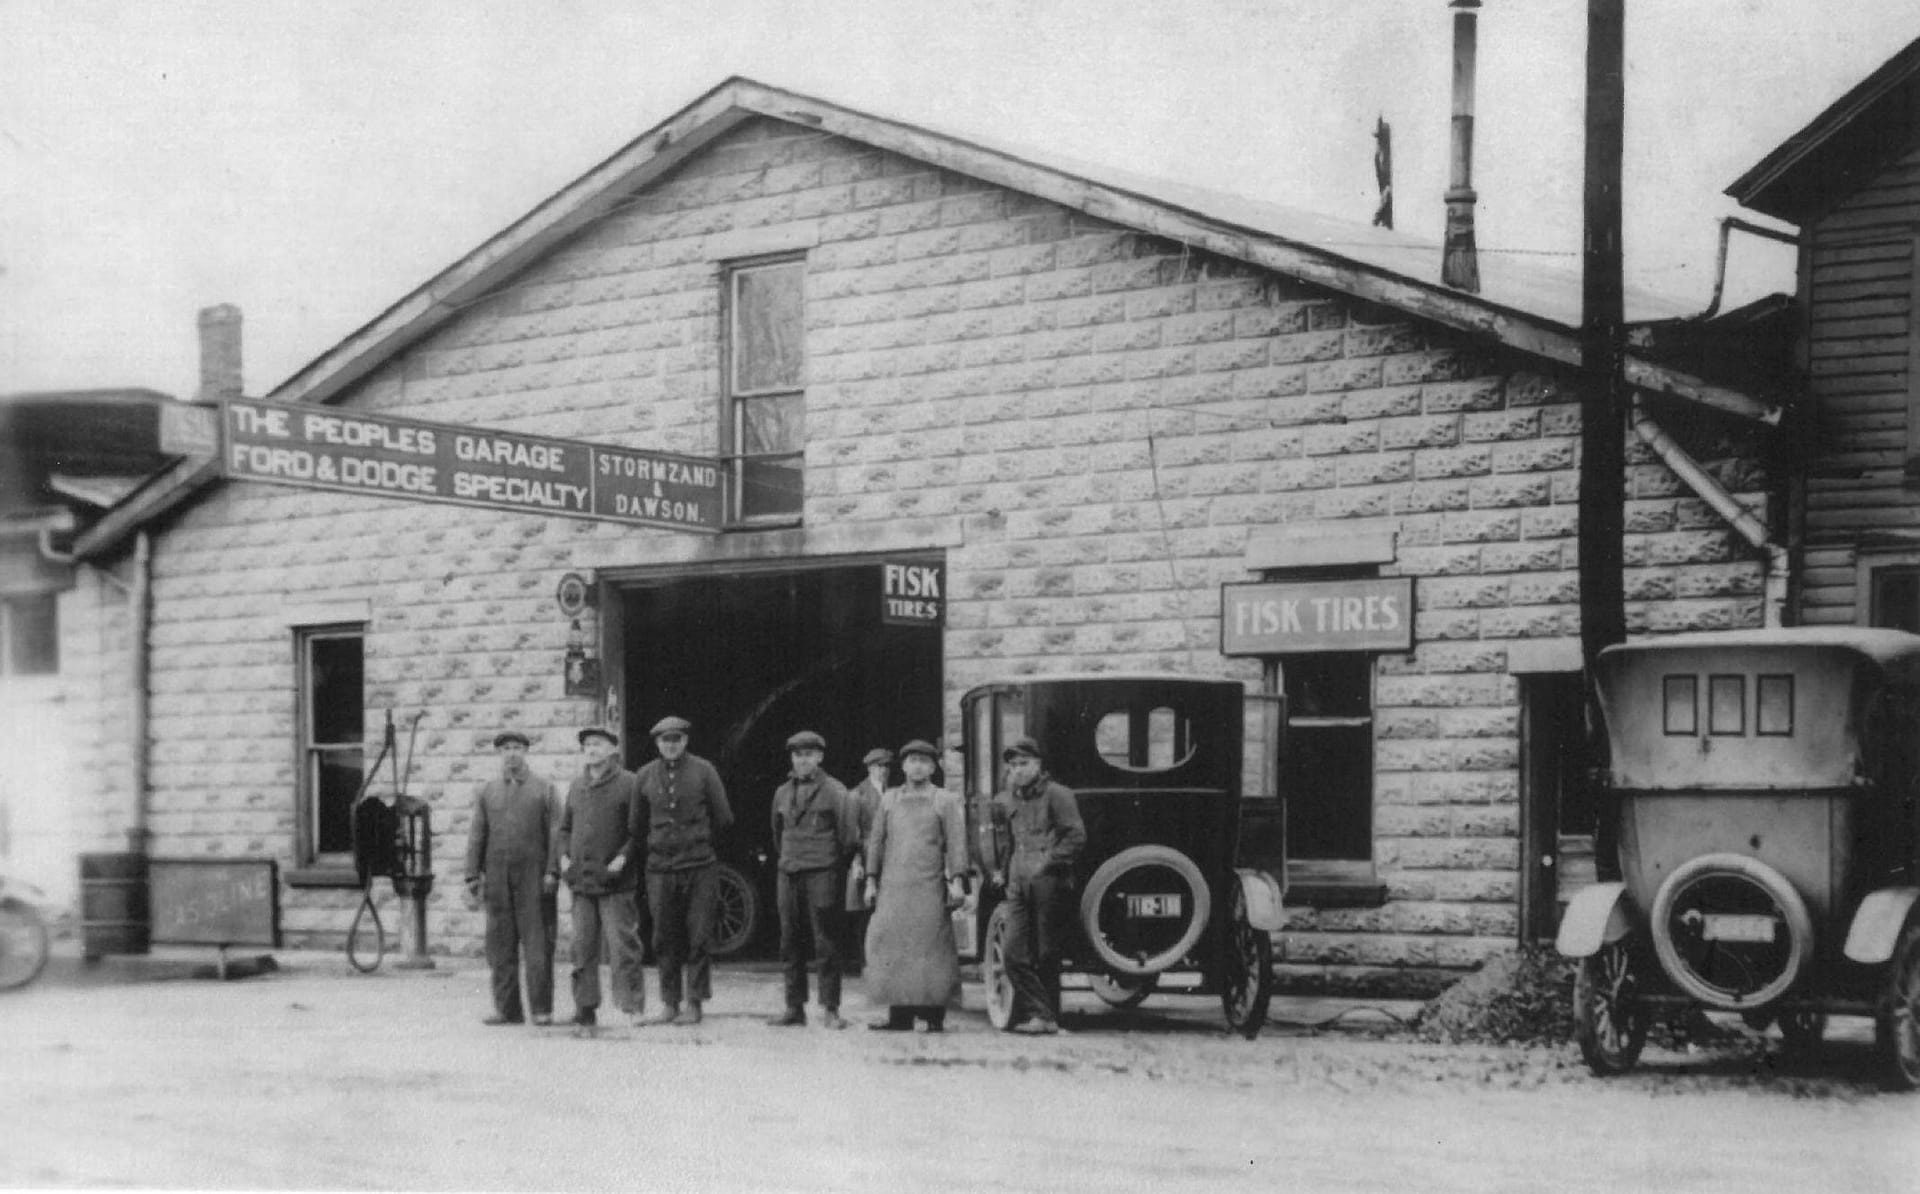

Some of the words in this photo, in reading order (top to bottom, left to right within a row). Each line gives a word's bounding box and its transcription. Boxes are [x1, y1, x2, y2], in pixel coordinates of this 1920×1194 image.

[230, 405, 290, 437] THE
[304, 414, 436, 455] PEOPLES
[455, 435, 565, 472] GARAGE
[233, 444, 314, 478] FORD
[341, 456, 437, 493] DODGE
[453, 471, 588, 510] SPECIALTY
[599, 454, 716, 488] STORMZAND
[885, 564, 940, 598] FISK
[887, 599, 938, 620] TIRES
[1236, 600, 1301, 636] FISK
[1310, 595, 1399, 633] TIRES
